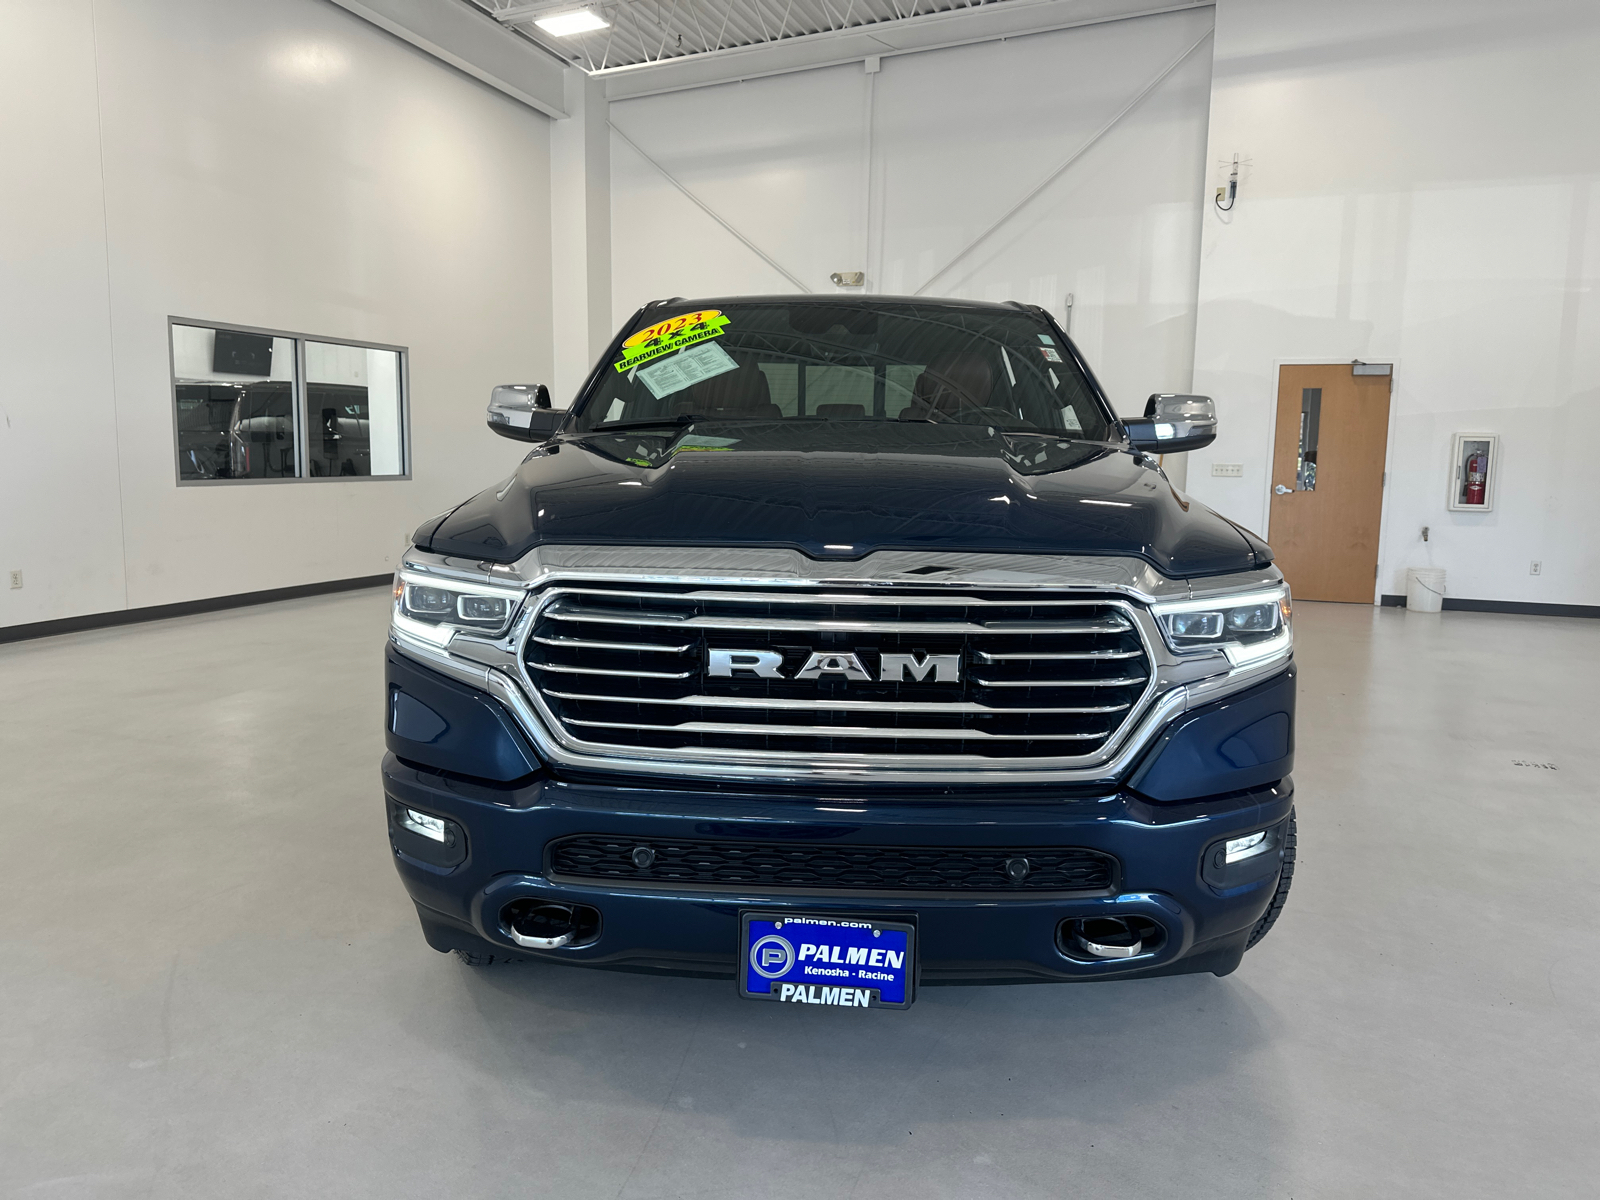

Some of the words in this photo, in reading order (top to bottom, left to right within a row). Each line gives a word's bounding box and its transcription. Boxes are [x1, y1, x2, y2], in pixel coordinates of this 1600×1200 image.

[642, 313, 703, 342] 2023
[619, 343, 673, 369] REARVIEW
[674, 328, 720, 347] CAMERA
[708, 648, 960, 682] RAM
[784, 917, 872, 929] palmen.com
[762, 948, 787, 966] P
[798, 943, 904, 969] PALMEN
[804, 965, 849, 977] Kenosha
[858, 970, 894, 981] Racine
[780, 983, 870, 1007] PALMEN
